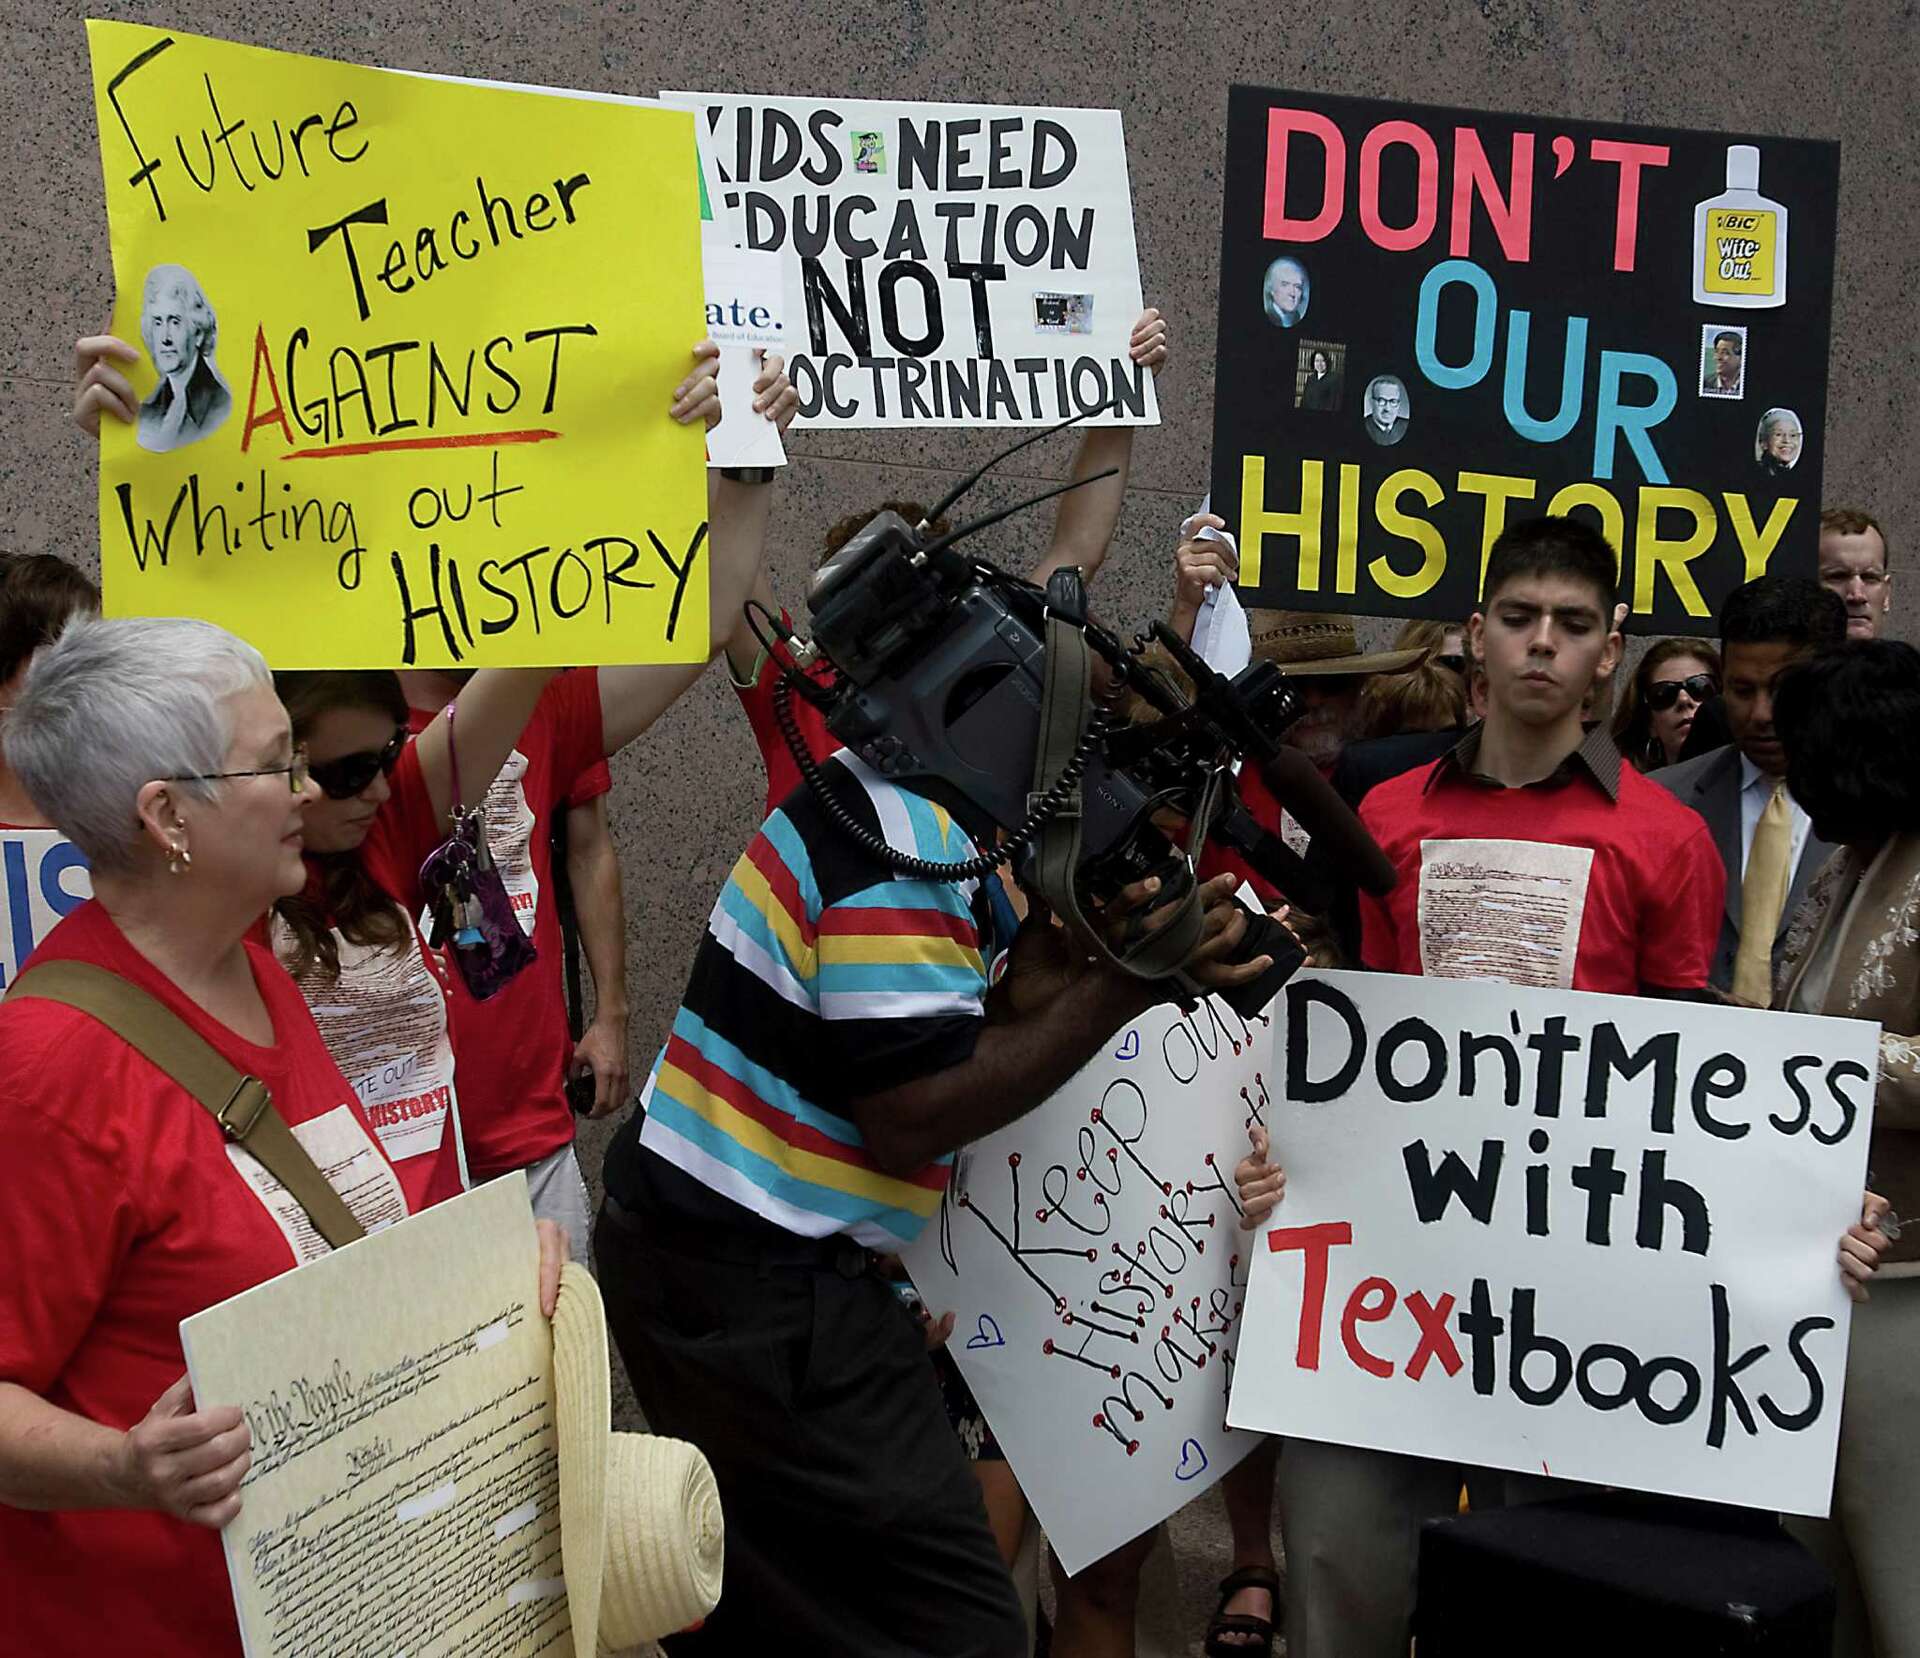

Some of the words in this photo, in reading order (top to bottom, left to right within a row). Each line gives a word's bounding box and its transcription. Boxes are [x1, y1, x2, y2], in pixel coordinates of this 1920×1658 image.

[107, 38, 369, 221] Future
[899, 118, 1078, 191] NEED
[1262, 106, 1670, 272] DON'T
[307, 173, 591, 321] Teacher
[725, 192, 1095, 270] DUCATION
[1719, 259, 1752, 280] Out
[705, 298, 783, 330] ate.
[801, 256, 1006, 360] NOT
[1415, 258, 1678, 484] OUR
[240, 322, 598, 454] AGAINST
[788, 353, 1145, 420] OCTRINATION
[116, 469, 366, 589] Whiting
[409, 451, 525, 529] out
[391, 521, 708, 664] HISTORY
[357, 1075, 378, 1099] TE
[384, 1055, 416, 1084] OUT
[1285, 978, 1581, 1119] Don't
[1584, 1021, 1869, 1145] Mess
